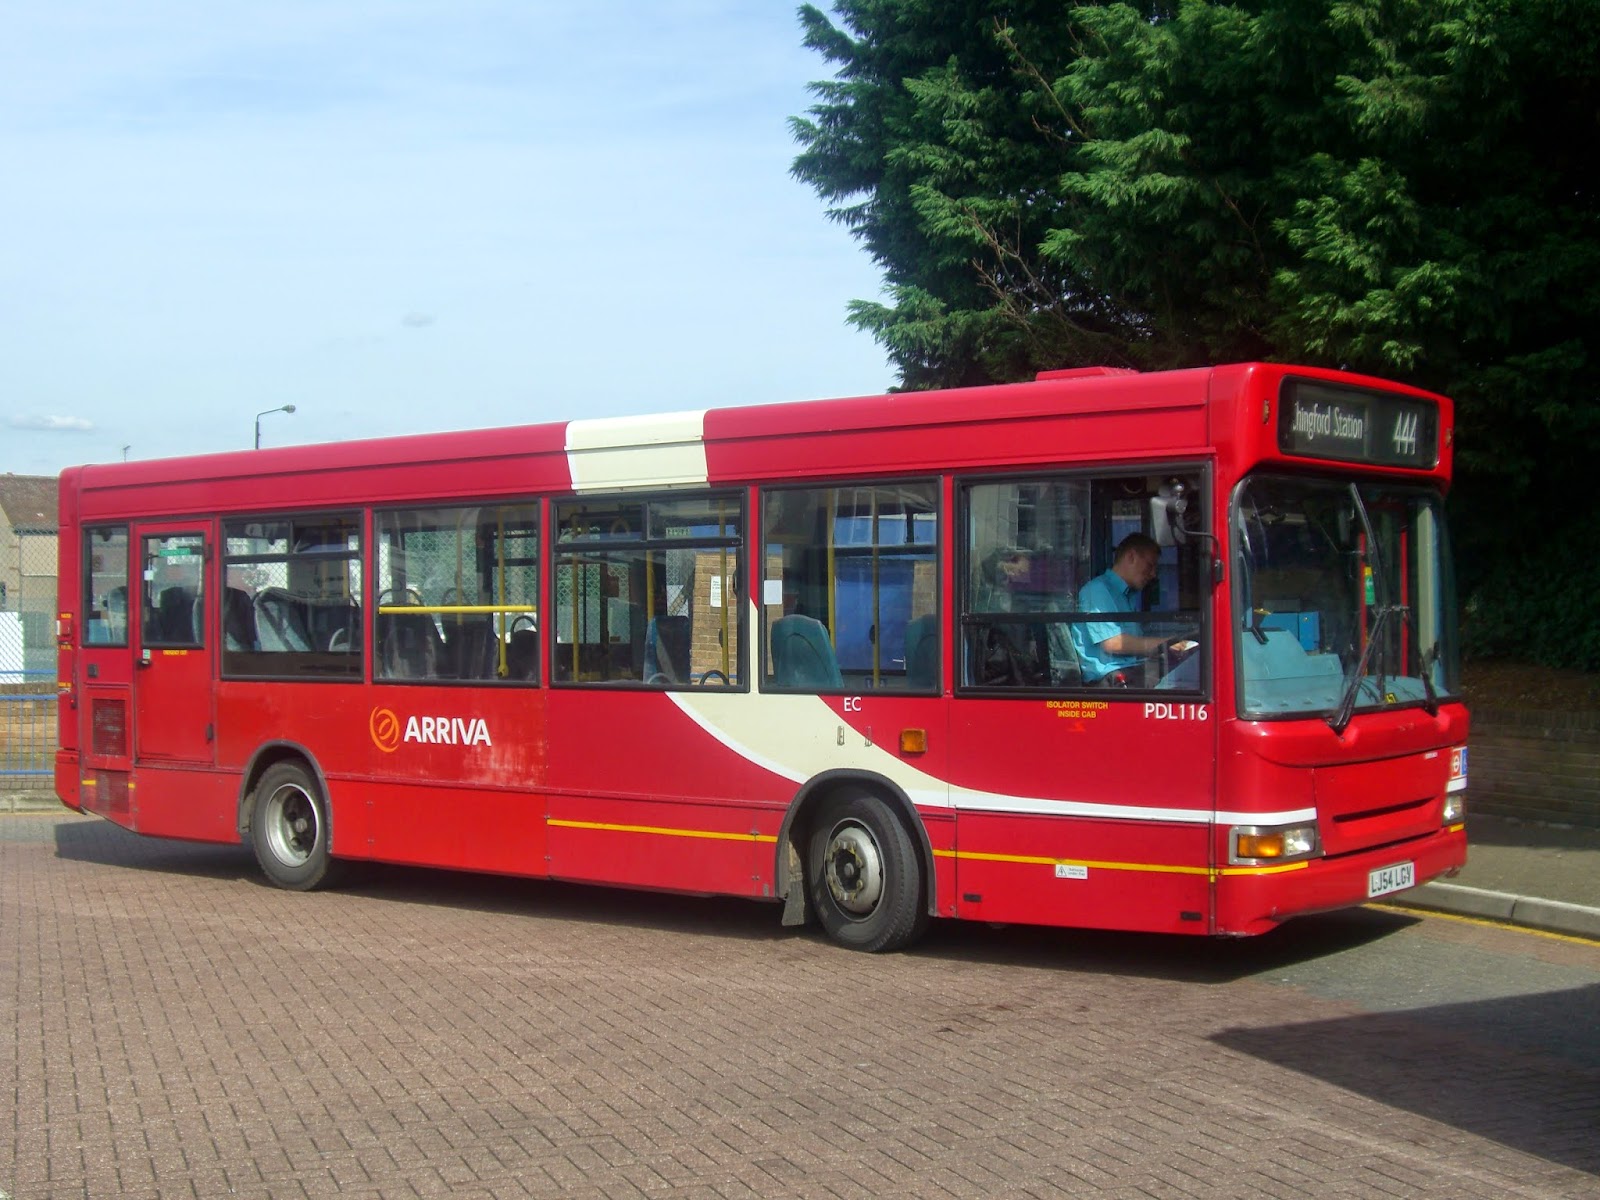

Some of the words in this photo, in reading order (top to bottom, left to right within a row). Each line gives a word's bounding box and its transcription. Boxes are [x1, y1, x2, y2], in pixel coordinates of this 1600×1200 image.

[1334, 406, 1363, 439] Station
[1393, 411, 1418, 455] 444
[843, 696, 862, 712] EC
[1046, 700, 1080, 709] ISOLATOR
[1081, 701, 1109, 710] SWITCH
[1057, 710, 1080, 718] INSIDE
[1081, 710, 1097, 718] CAB
[1144, 702, 1208, 721] PDL116
[403, 715, 493, 747] ARRIVA
[1371, 870, 1393, 893] LJ54
